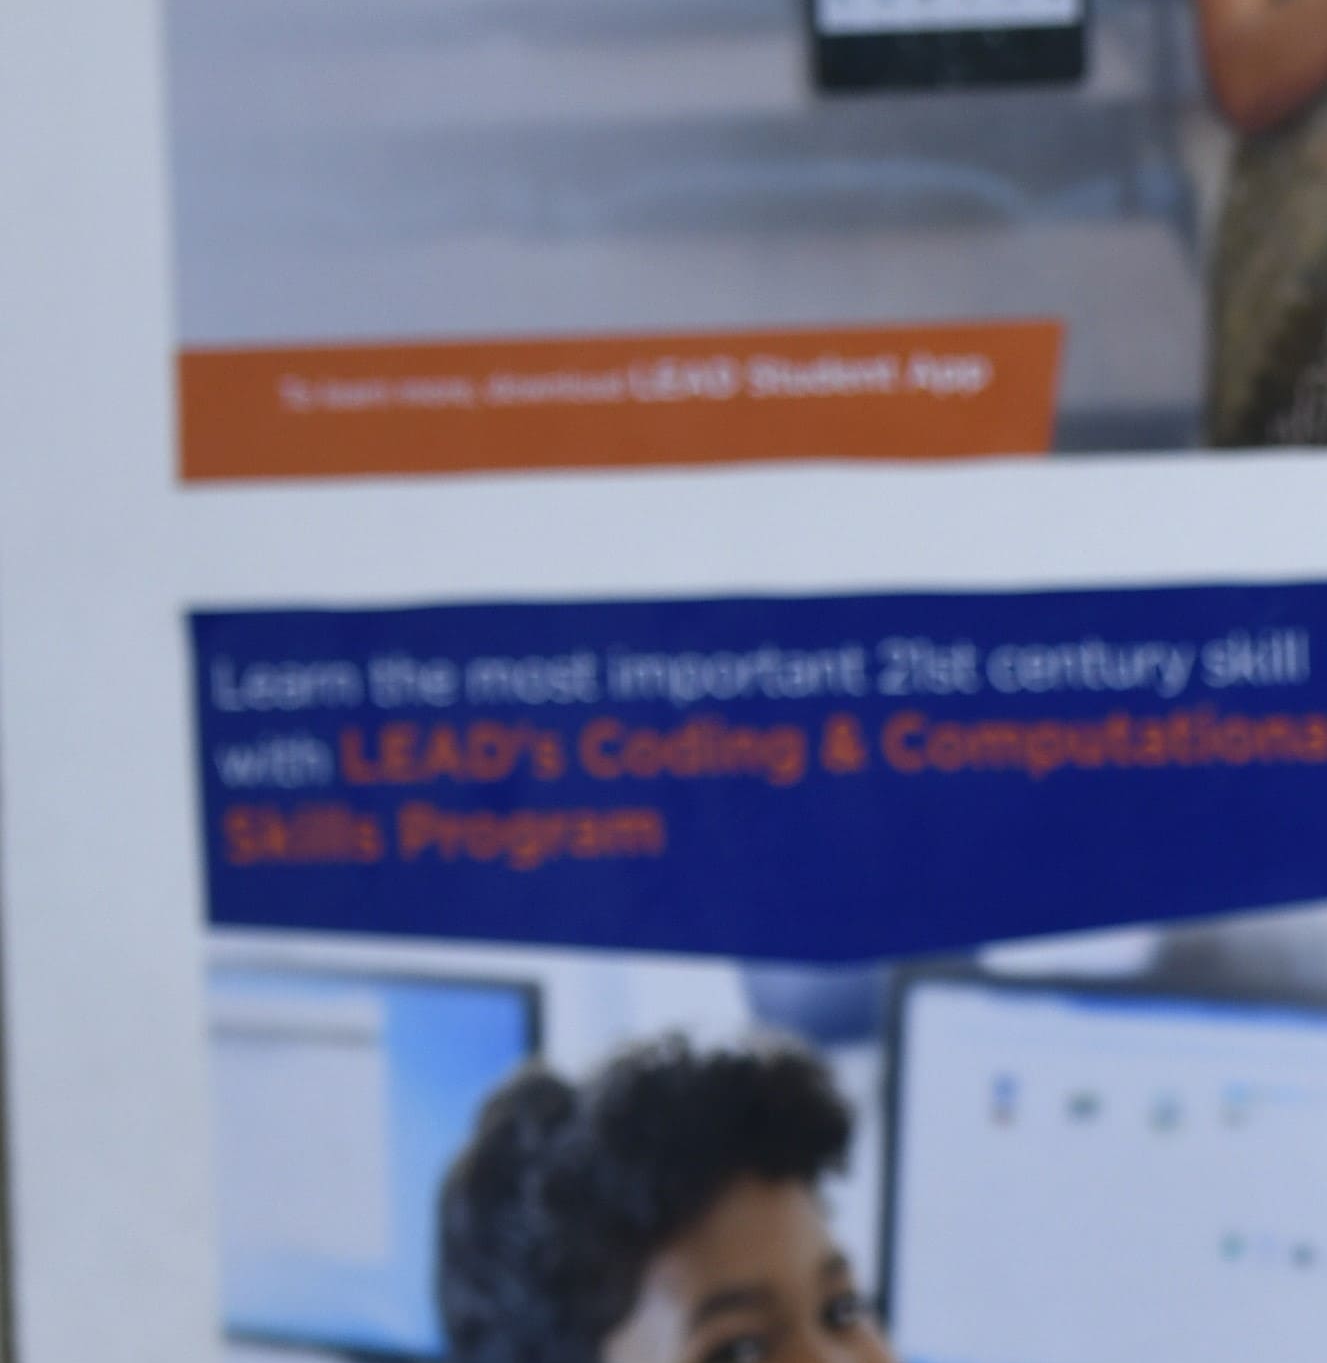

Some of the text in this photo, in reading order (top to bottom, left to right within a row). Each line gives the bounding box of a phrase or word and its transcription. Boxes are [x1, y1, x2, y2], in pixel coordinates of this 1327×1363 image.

[628, 357, 740, 401] LEAD
[745, 354, 899, 397] Student
[905, 351, 991, 394] App
[210, 628, 1310, 712] Learn the most important 21st century skill
[216, 730, 336, 789] with
[340, 721, 564, 783] LEAD's
[579, 711, 806, 786] Coding
[820, 711, 866, 774] &
[224, 801, 665, 871] Skills Program
